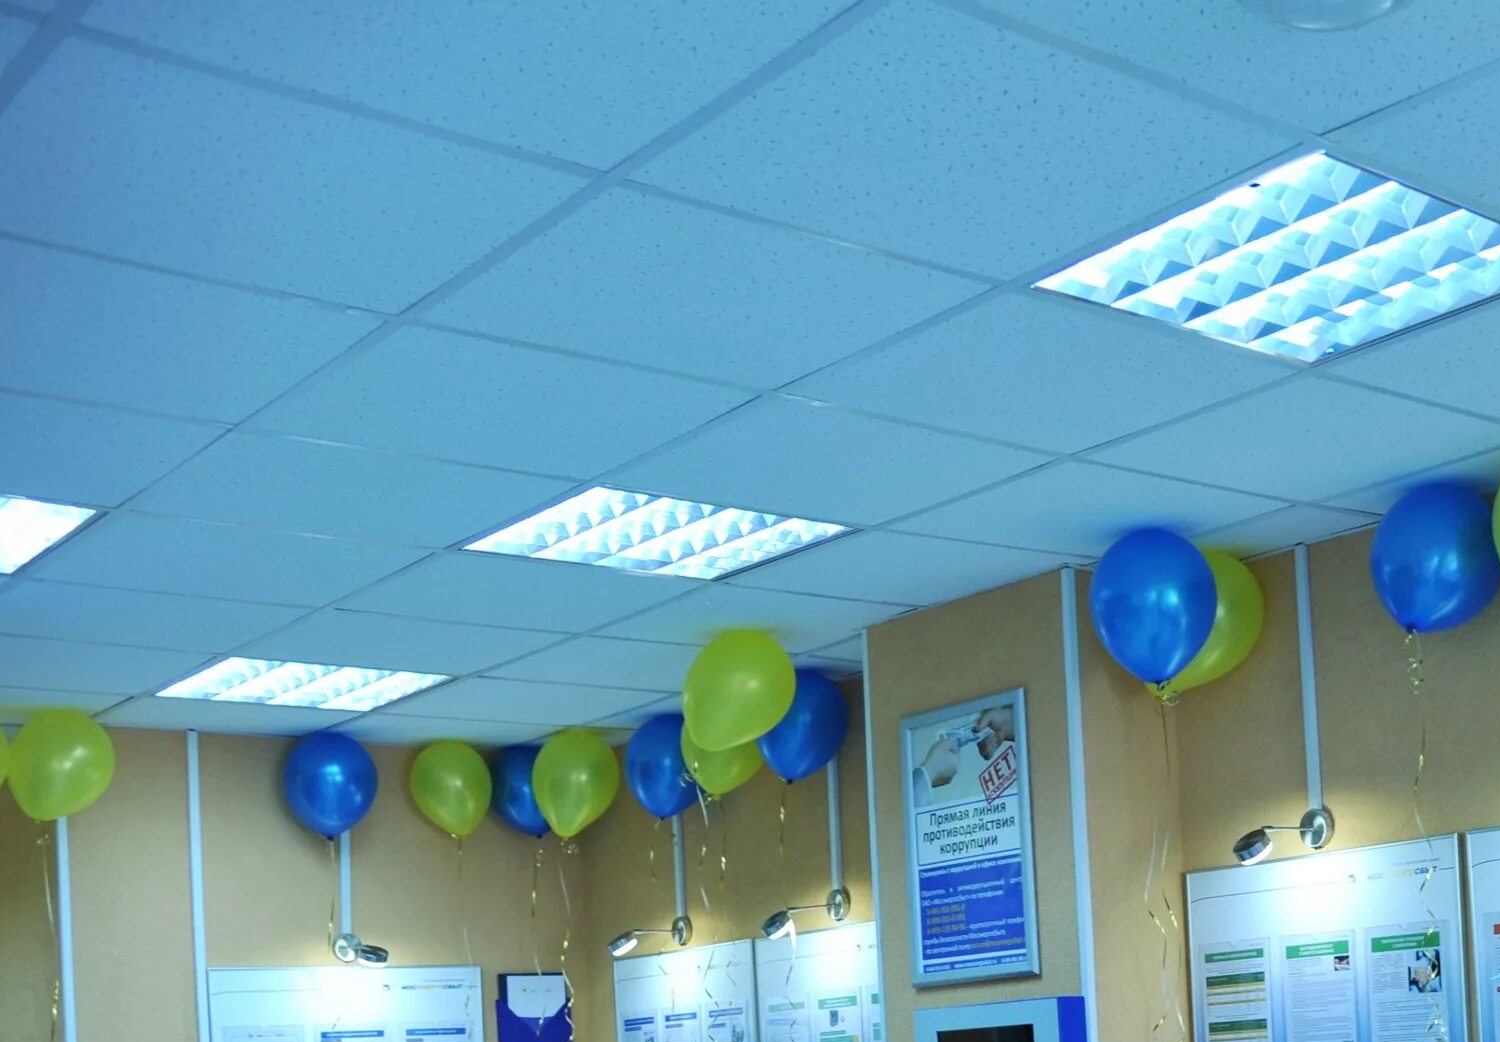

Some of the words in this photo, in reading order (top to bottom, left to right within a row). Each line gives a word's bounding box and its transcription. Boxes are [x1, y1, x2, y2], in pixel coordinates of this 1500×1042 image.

[982, 751, 1012, 791] НЕТ
[929, 807, 970, 829] Прямая
[972, 800, 1007, 820] линия
[922, 815, 1016, 845] противодействия
[939, 834, 999, 857] коррупции
